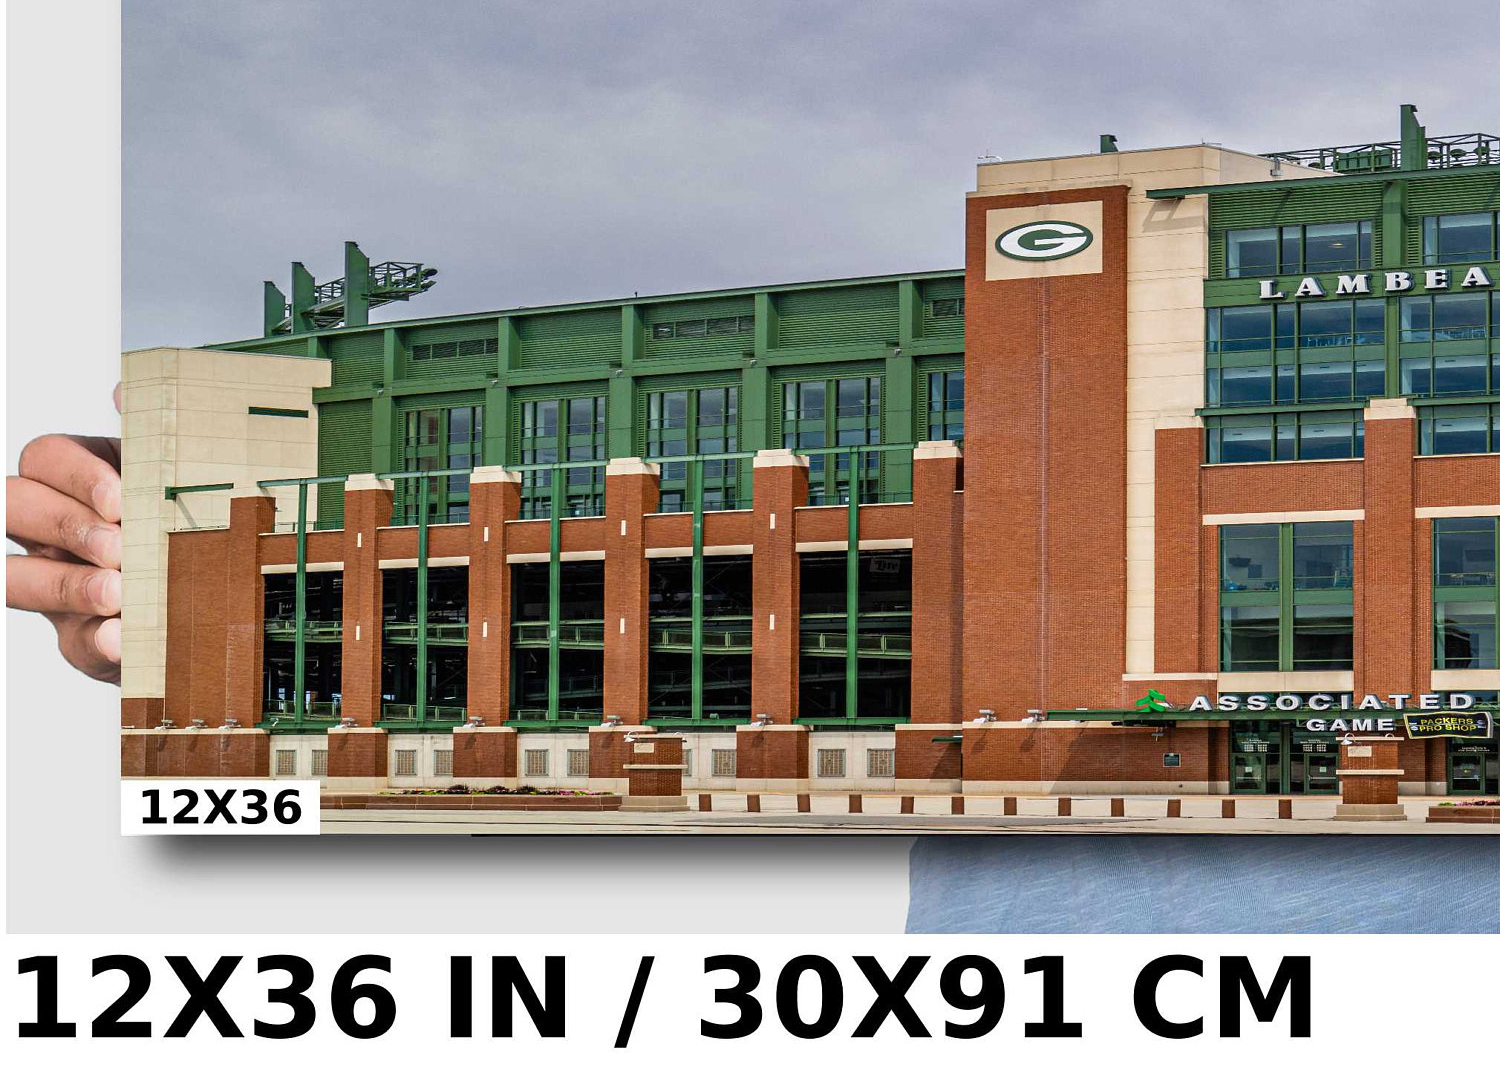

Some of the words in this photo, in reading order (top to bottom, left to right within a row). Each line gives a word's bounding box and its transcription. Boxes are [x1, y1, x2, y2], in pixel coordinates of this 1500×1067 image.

[998, 222, 1089, 259] G
[1189, 693, 1475, 711] ASSOCIATED
[1306, 718, 1395, 732] GAME
[1420, 717, 1474, 725] PACKERS
[1445, 724, 1477, 732] SHOP
